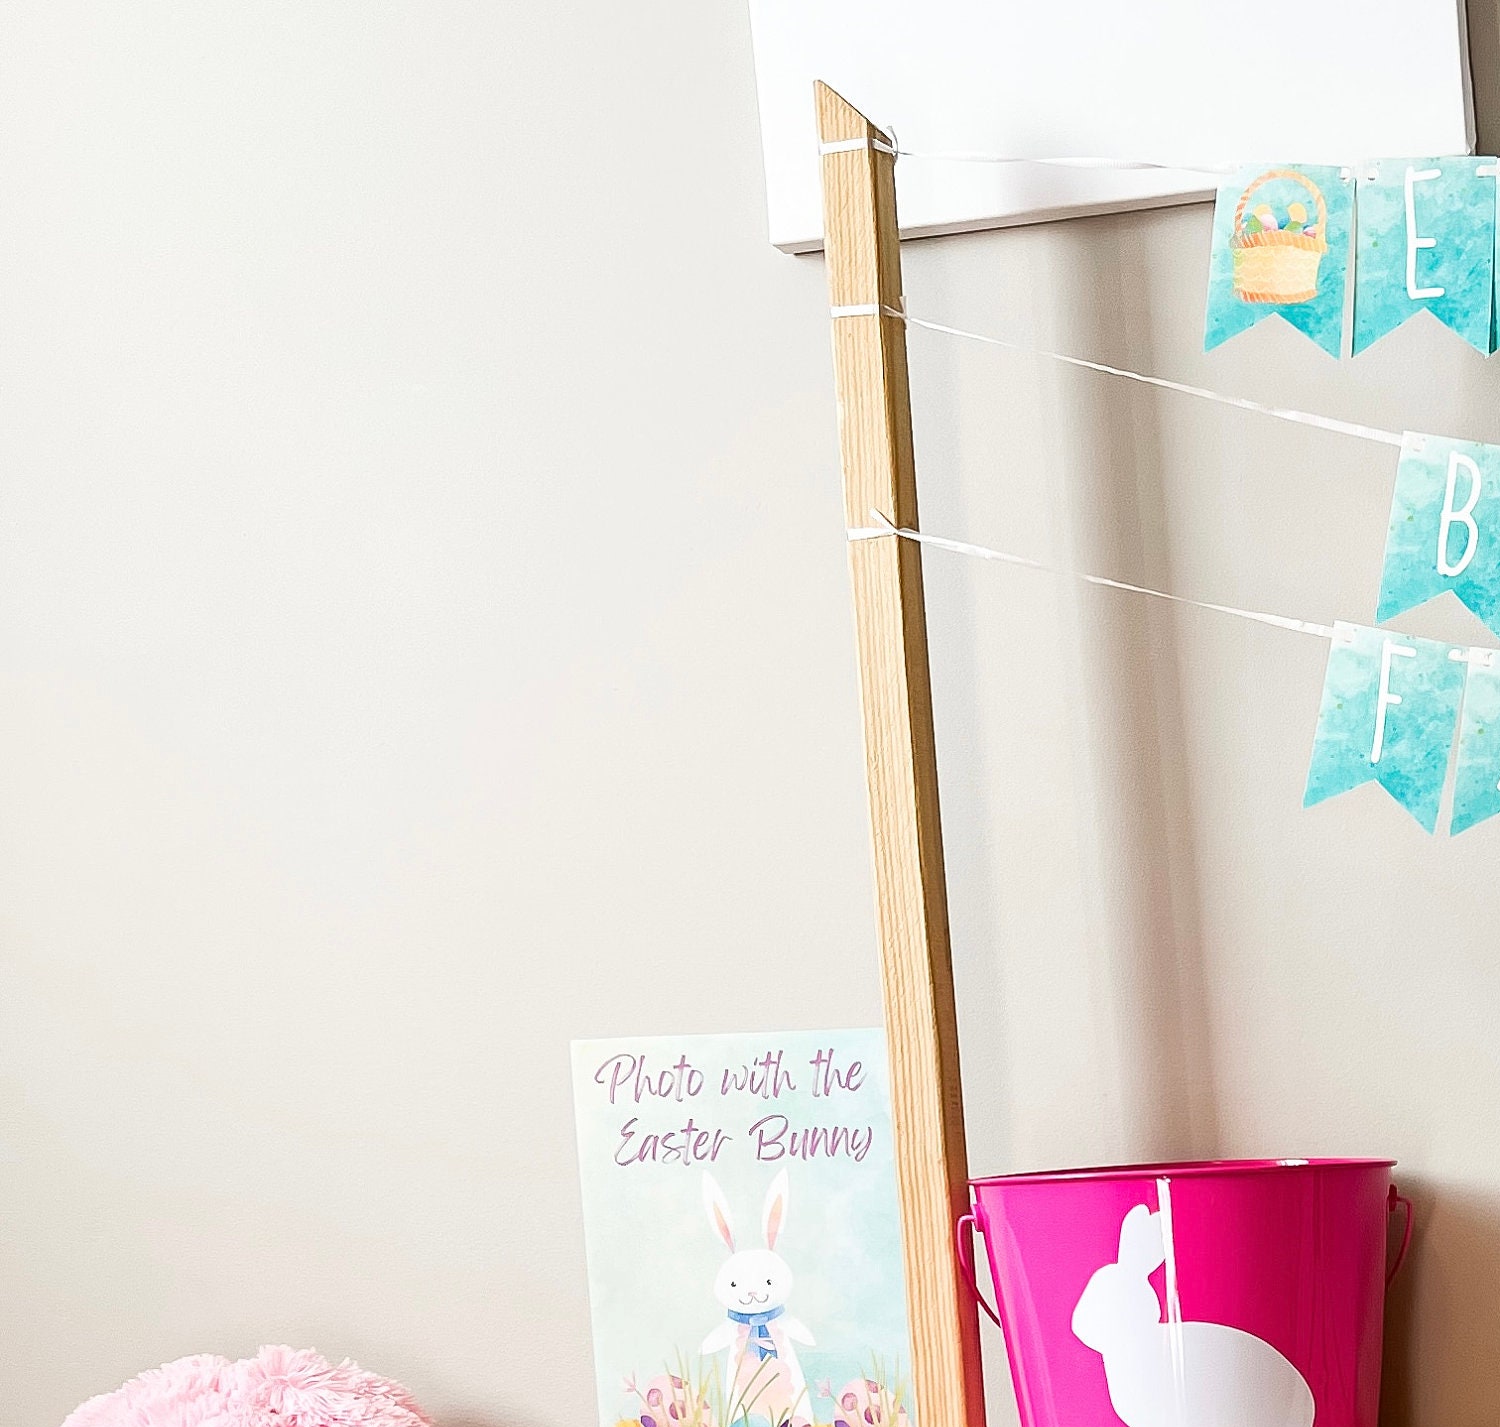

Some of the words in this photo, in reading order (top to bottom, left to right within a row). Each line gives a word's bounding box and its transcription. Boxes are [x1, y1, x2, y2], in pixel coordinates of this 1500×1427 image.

[594, 1053, 704, 1104] Photo
[720, 1049, 797, 1100] with
[808, 1048, 868, 1098] the
[613, 1117, 733, 1167] Easter
[748, 1114, 873, 1163] Bunny
